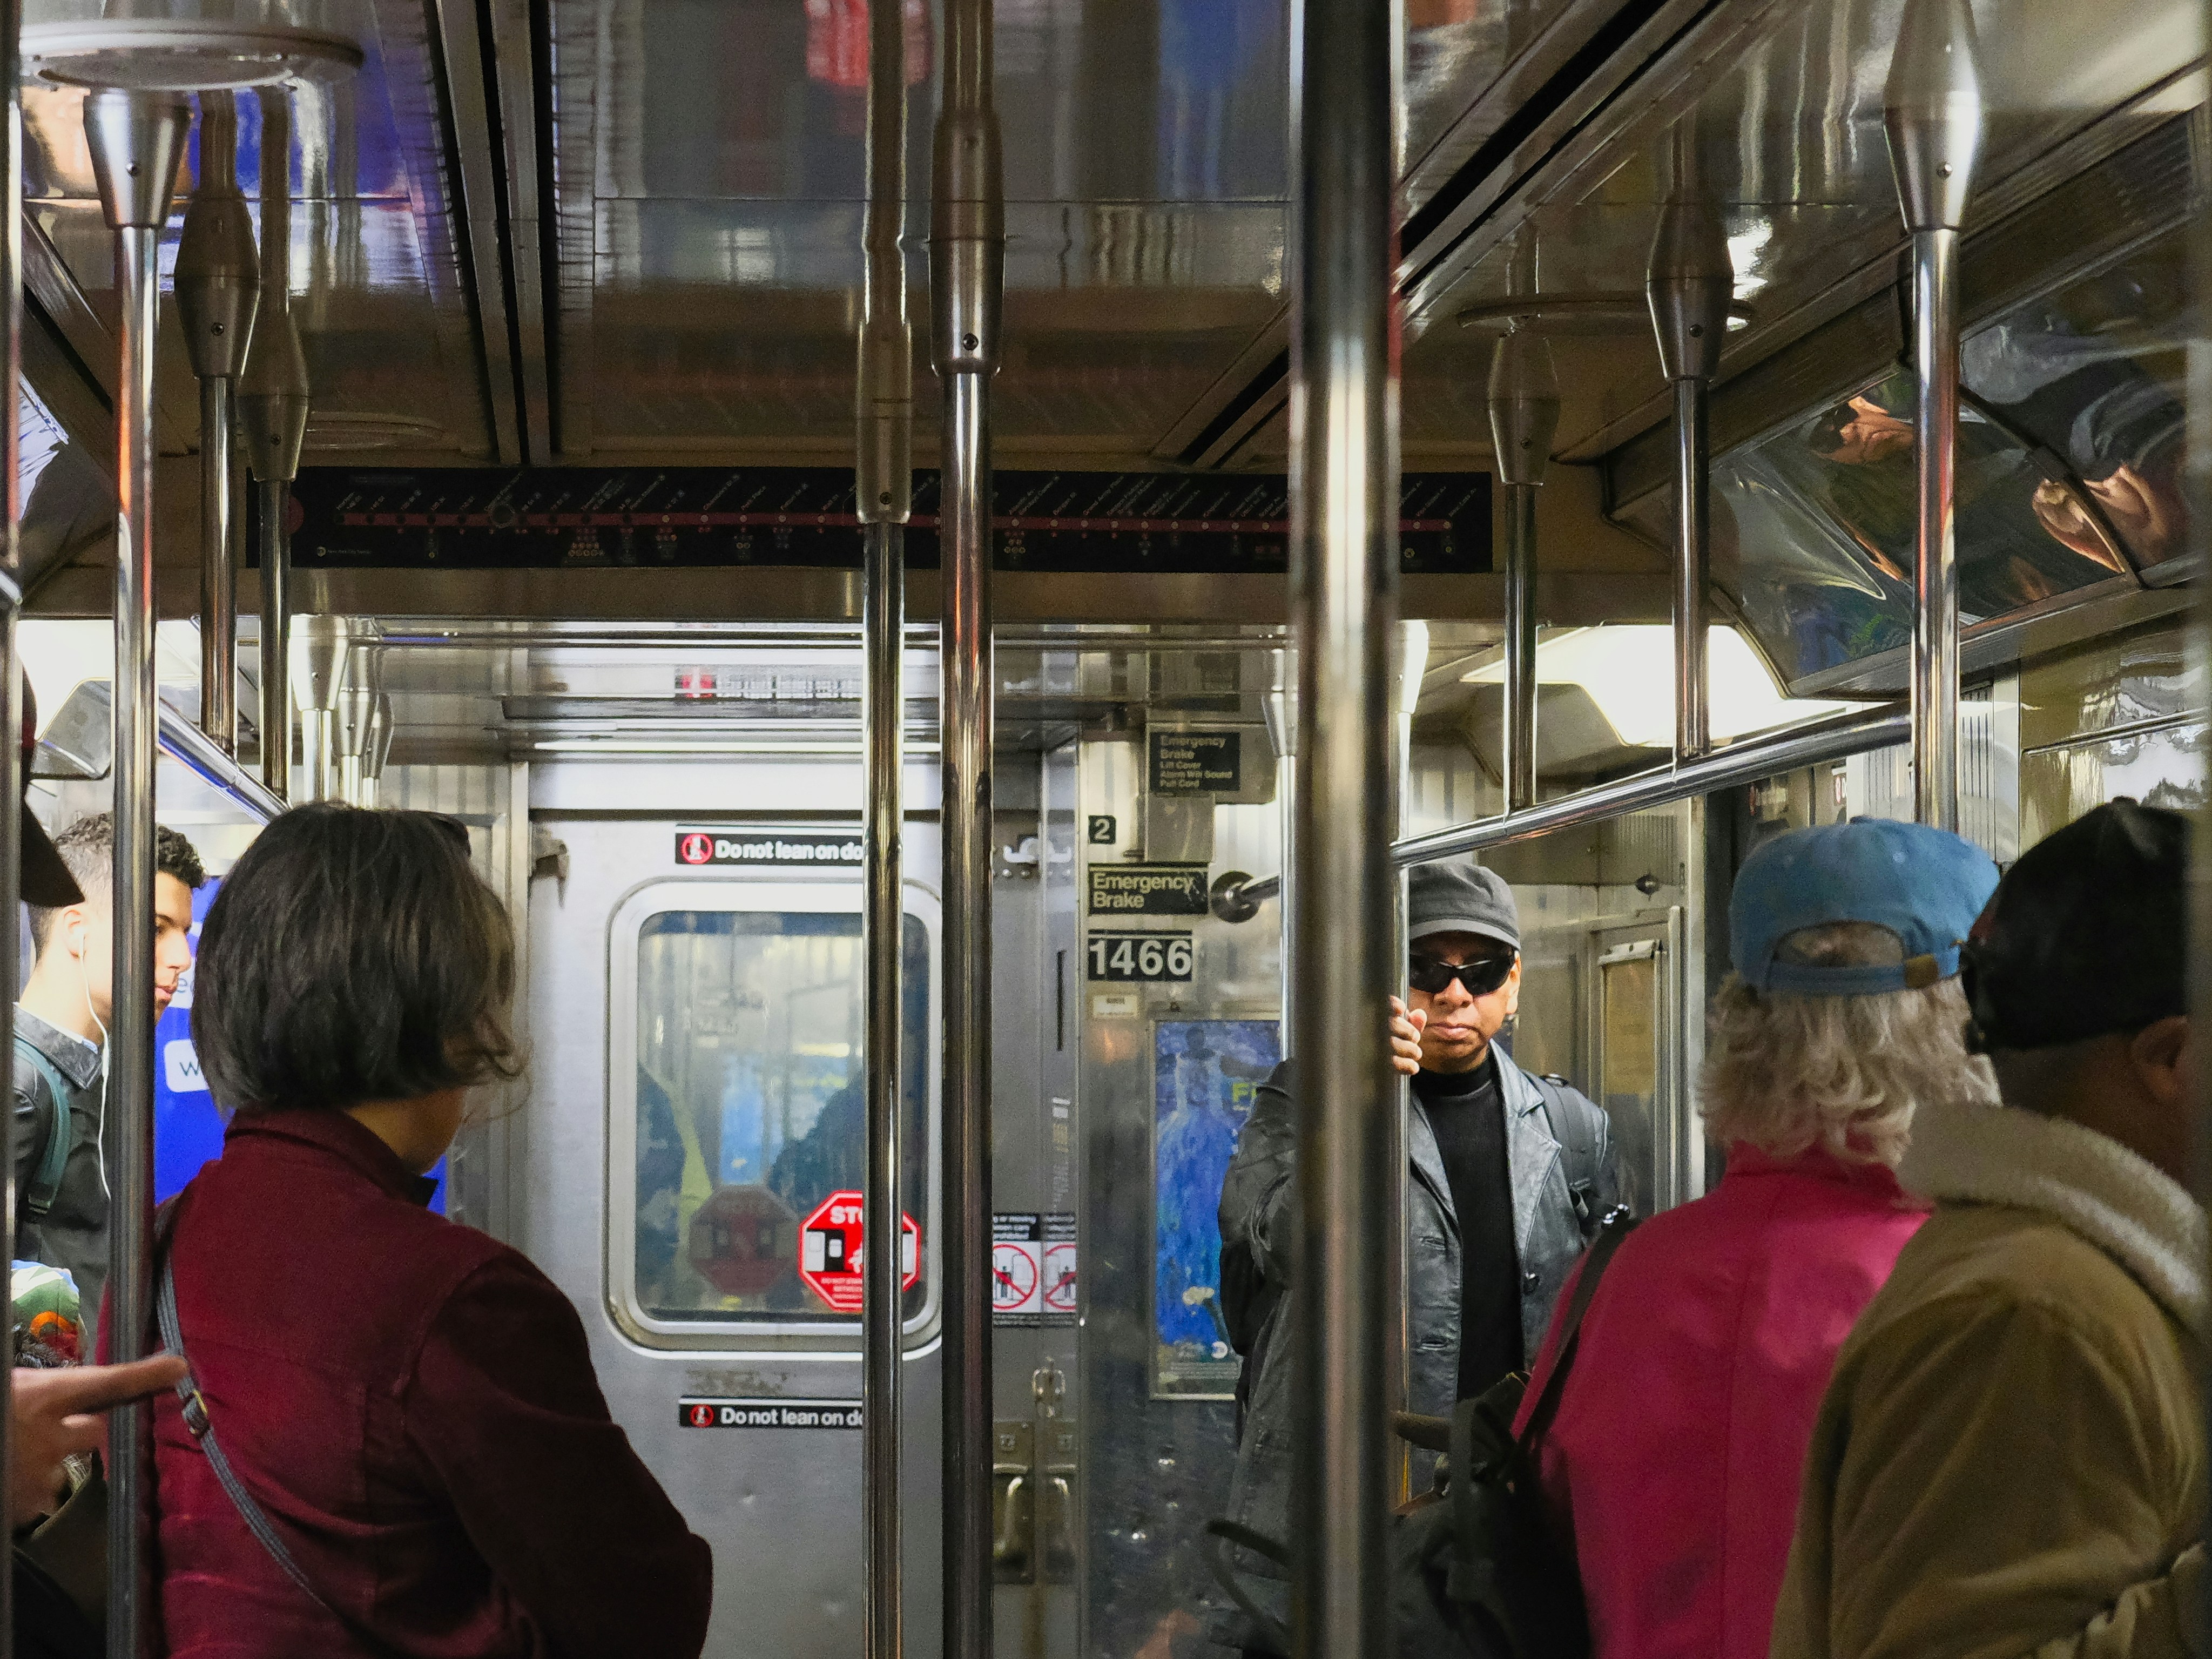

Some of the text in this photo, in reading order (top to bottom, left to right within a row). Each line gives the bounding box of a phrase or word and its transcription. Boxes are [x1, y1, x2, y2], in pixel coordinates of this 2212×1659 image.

[1161, 735, 1226, 748] Emergency
[1161, 749, 1195, 759] Brake
[1094, 818, 1110, 840] 2
[715, 840, 742, 859] Do
[743, 841, 773, 859] not
[775, 841, 814, 860] lean
[815, 845, 839, 860] on
[1094, 873, 1193, 894] Emergency
[1094, 891, 1144, 909] Brake
[1089, 940, 1191, 976] 1466
[830, 1205, 863, 1225] ST
[720, 1407, 746, 1425] Do
[748, 1409, 778, 1426] not
[781, 1408, 819, 1426] lean
[821, 1411, 844, 1426] on
